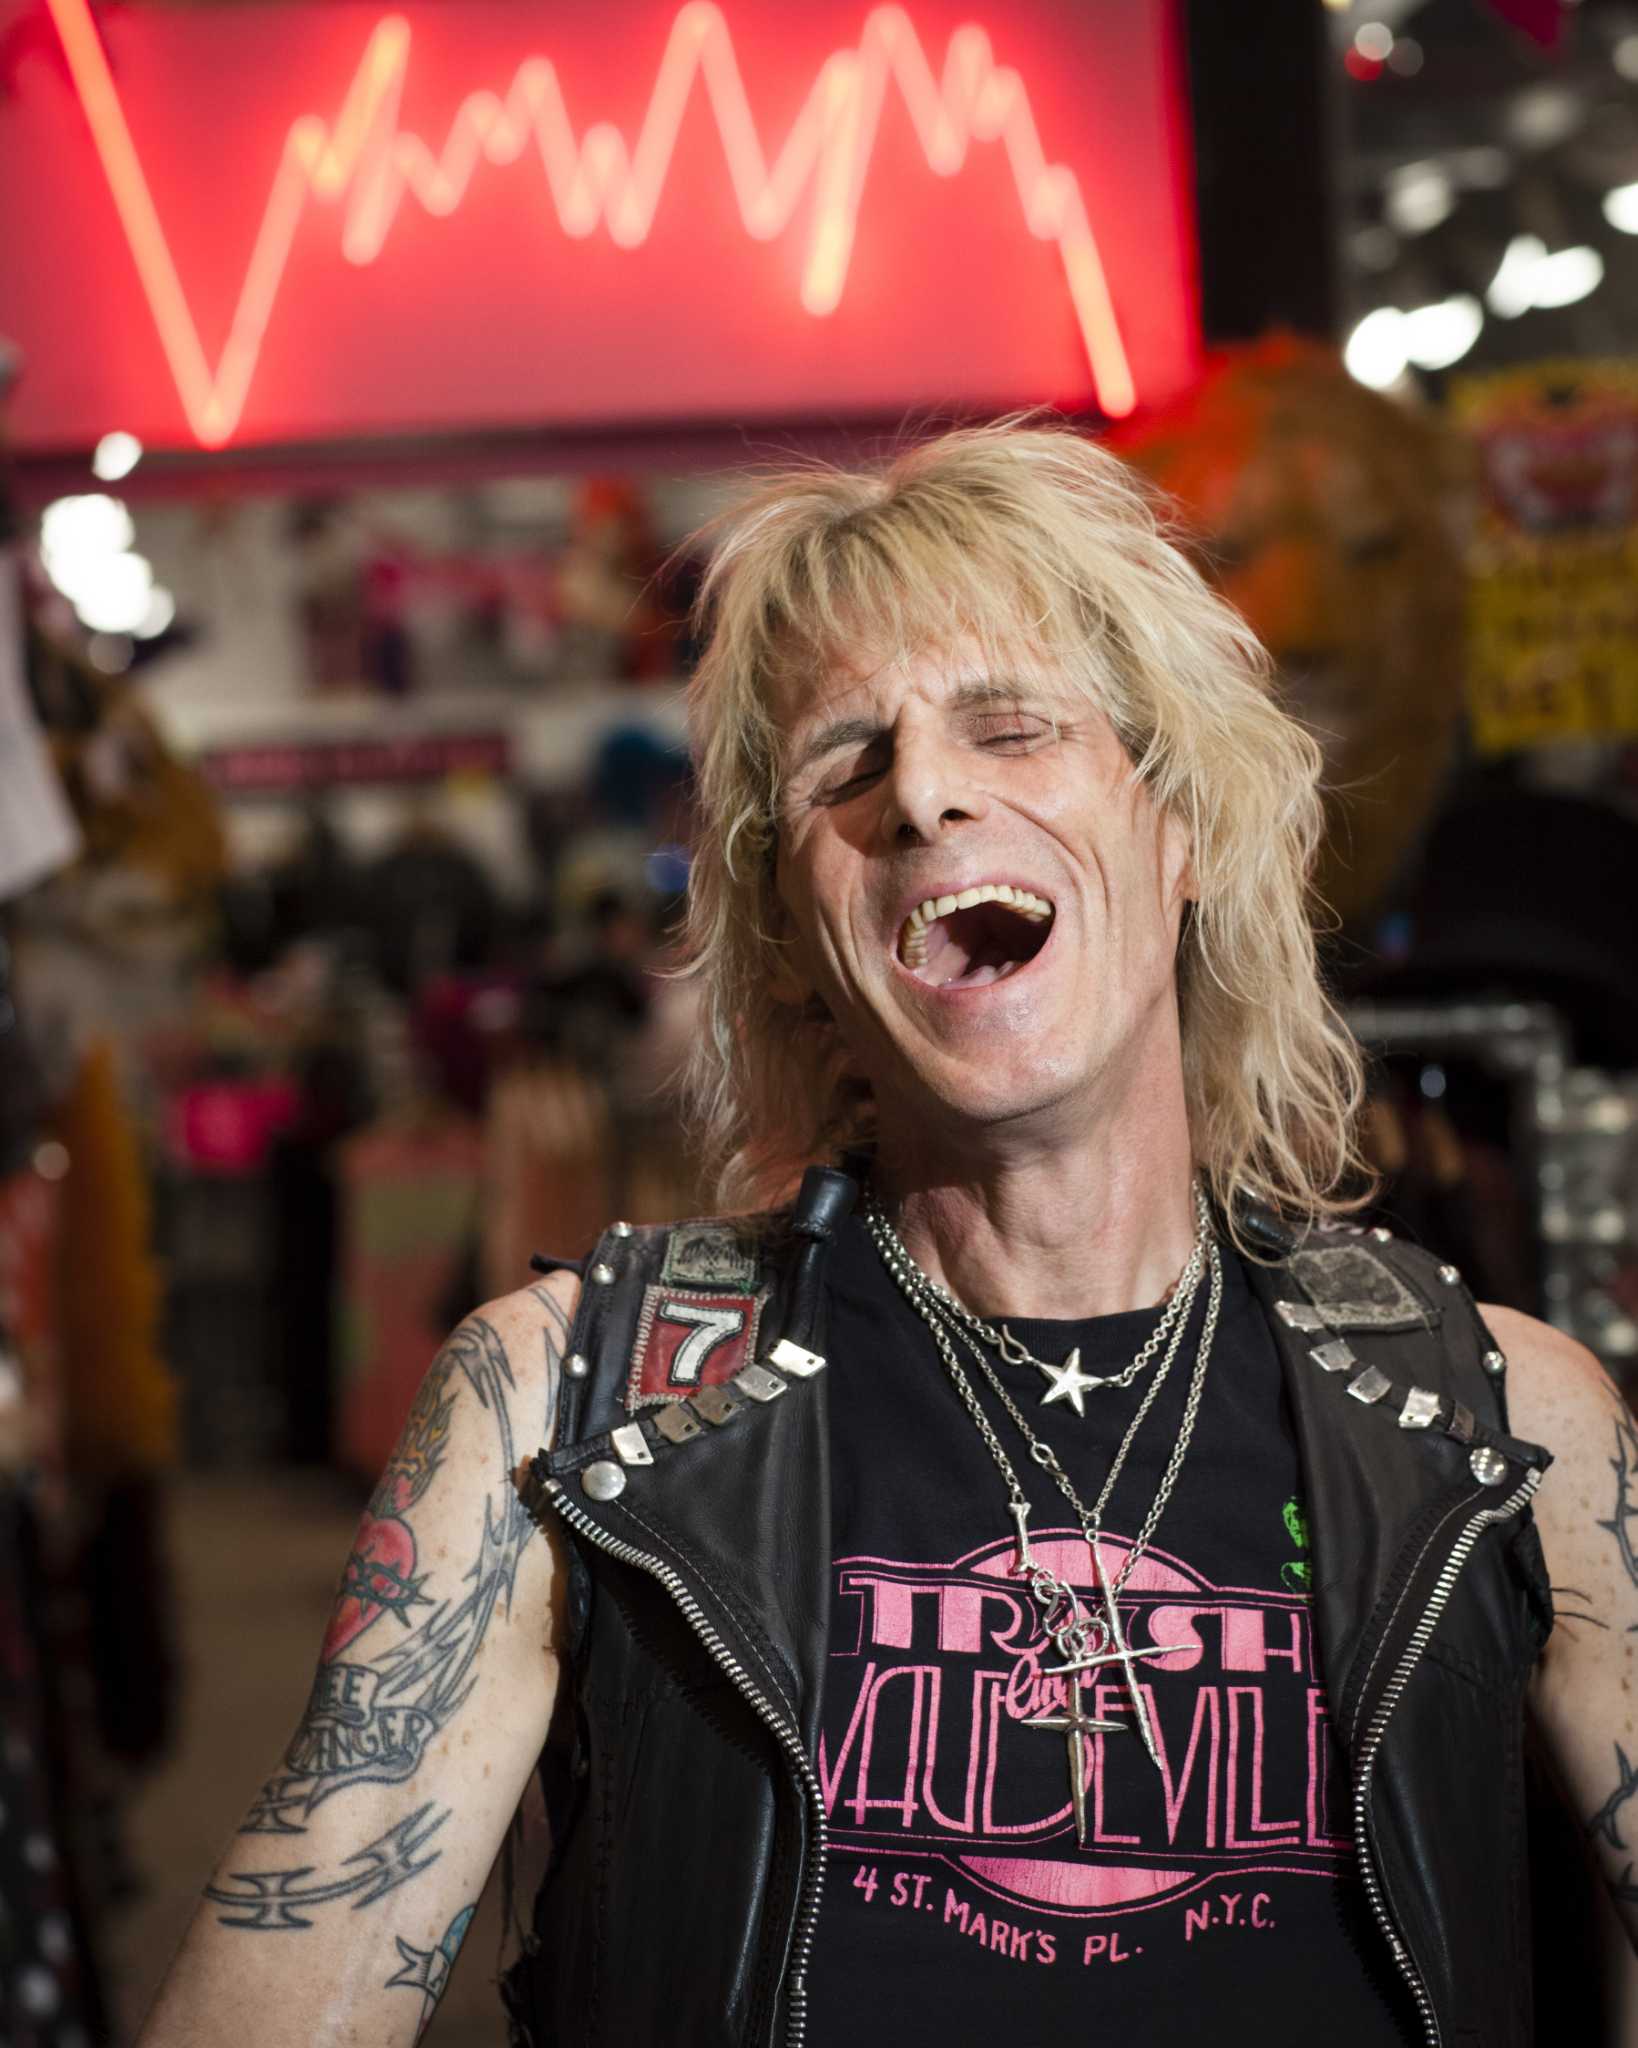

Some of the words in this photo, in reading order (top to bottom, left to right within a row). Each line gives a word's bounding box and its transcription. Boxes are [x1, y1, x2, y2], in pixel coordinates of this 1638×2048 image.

[656, 1301, 745, 1386] 7
[852, 1864, 879, 1903] 4
[889, 1871, 934, 1911] ST.
[942, 1887, 1058, 1966] MARK'S
[1083, 1932, 1145, 1966] PL.
[1184, 1892, 1276, 1941] N.Y.C.
